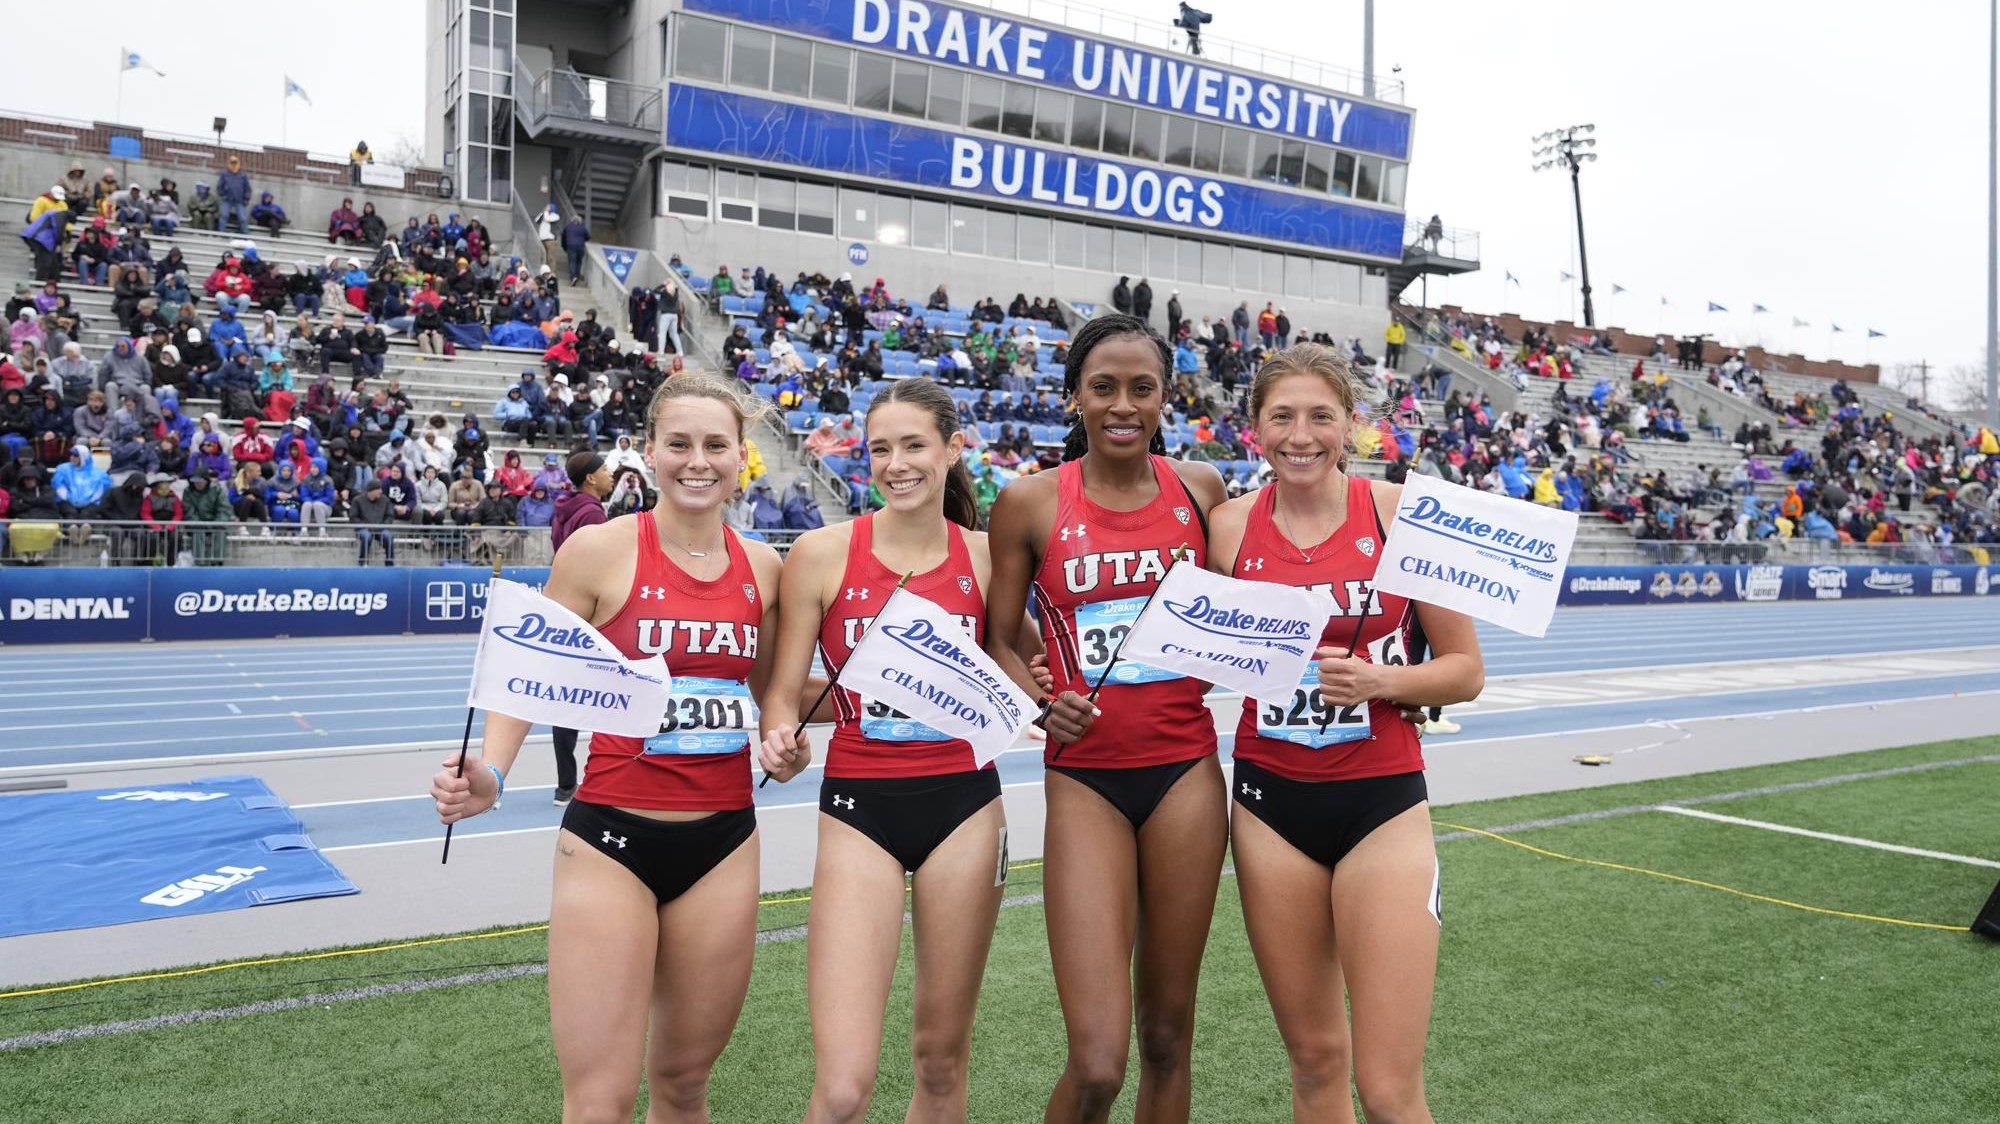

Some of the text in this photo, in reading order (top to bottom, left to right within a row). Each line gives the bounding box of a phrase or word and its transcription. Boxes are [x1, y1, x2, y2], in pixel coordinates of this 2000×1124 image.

[853, 0, 1352, 143] DRAKE UNIVERSITY
[951, 137, 1225, 227] BULLDOGS
[1409, 496, 1556, 559] Drake RELAYS
[1400, 555, 1520, 605] CHAMPION
[10, 597, 131, 620] DENTAL
[174, 588, 389, 617] @DrakeRelays
[1181, 595, 1310, 635] Drake RELAYS
[513, 613, 597, 650] Drake
[637, 618, 758, 660] UTAH
[900, 618, 976, 668] Drake
[973, 669, 1021, 718] RELAYS
[1161, 643, 1269, 676] CHAMPION
[507, 677, 632, 711] CHAMPION
[881, 667, 992, 729] CHAMPION
[1262, 687, 1363, 727] 3292
[658, 697, 744, 733] 3301
